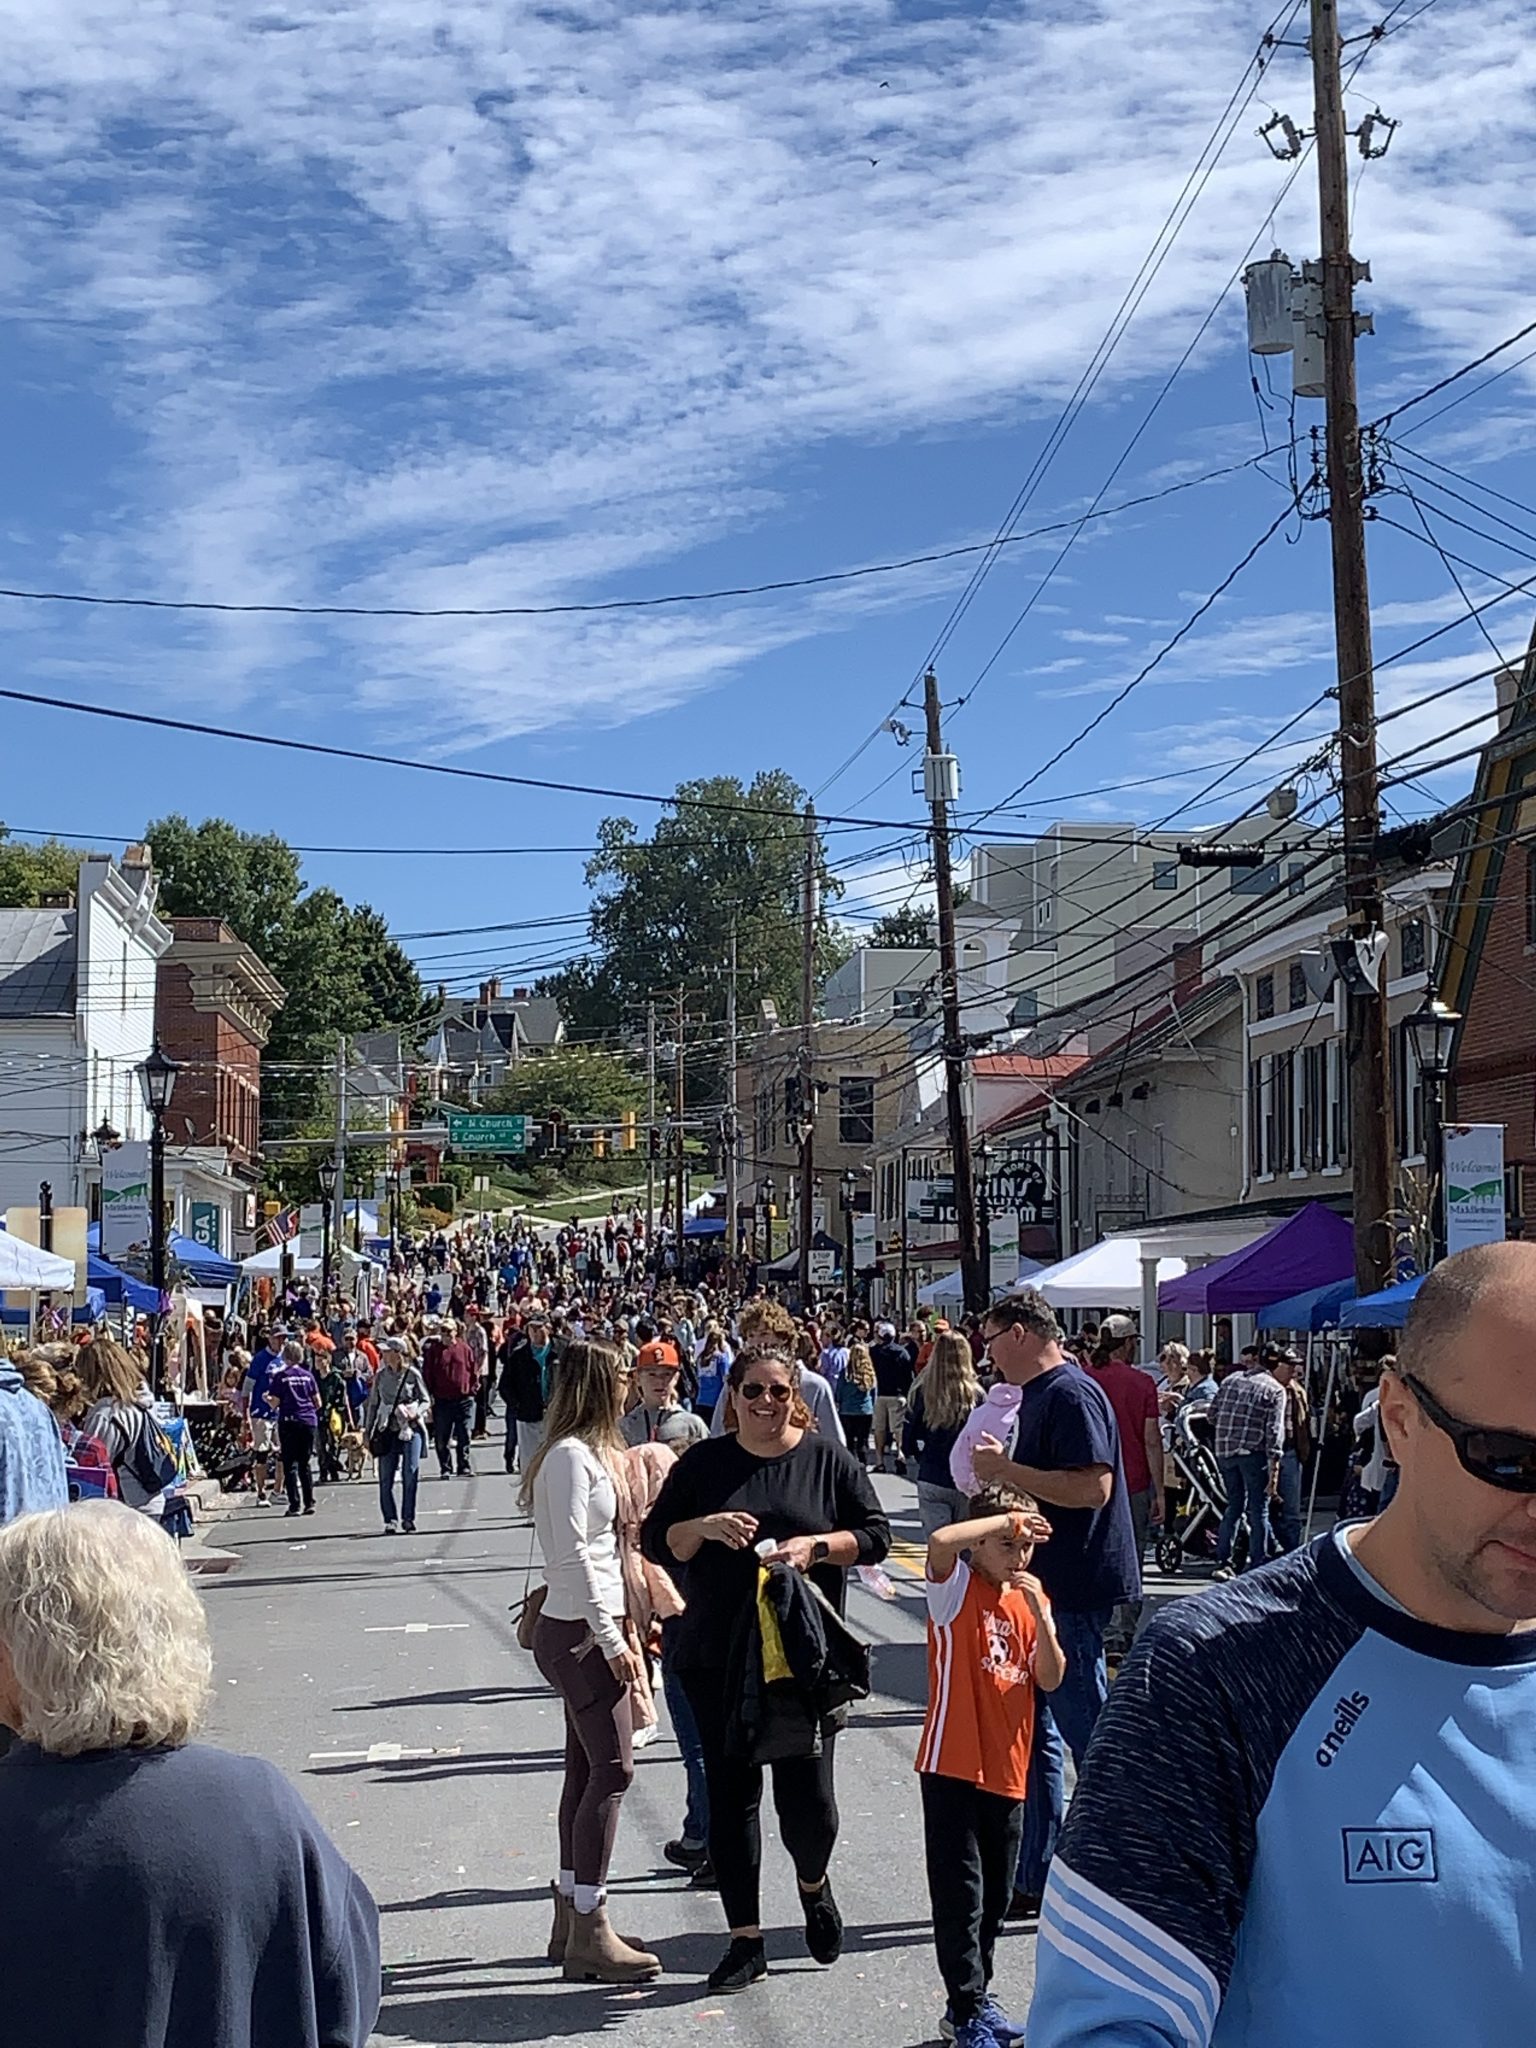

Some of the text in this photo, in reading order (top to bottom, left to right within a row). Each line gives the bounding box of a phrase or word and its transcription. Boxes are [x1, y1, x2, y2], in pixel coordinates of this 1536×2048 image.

[468, 1119, 475, 1128] N
[479, 1119, 512, 1128] Church
[451, 1132, 458, 1141] S
[462, 1132, 496, 1142] Church
[1003, 1162, 1030, 1176] HOME
[1449, 1205, 1502, 1215] Middletown
[1356, 1838, 1425, 1872] AIG
